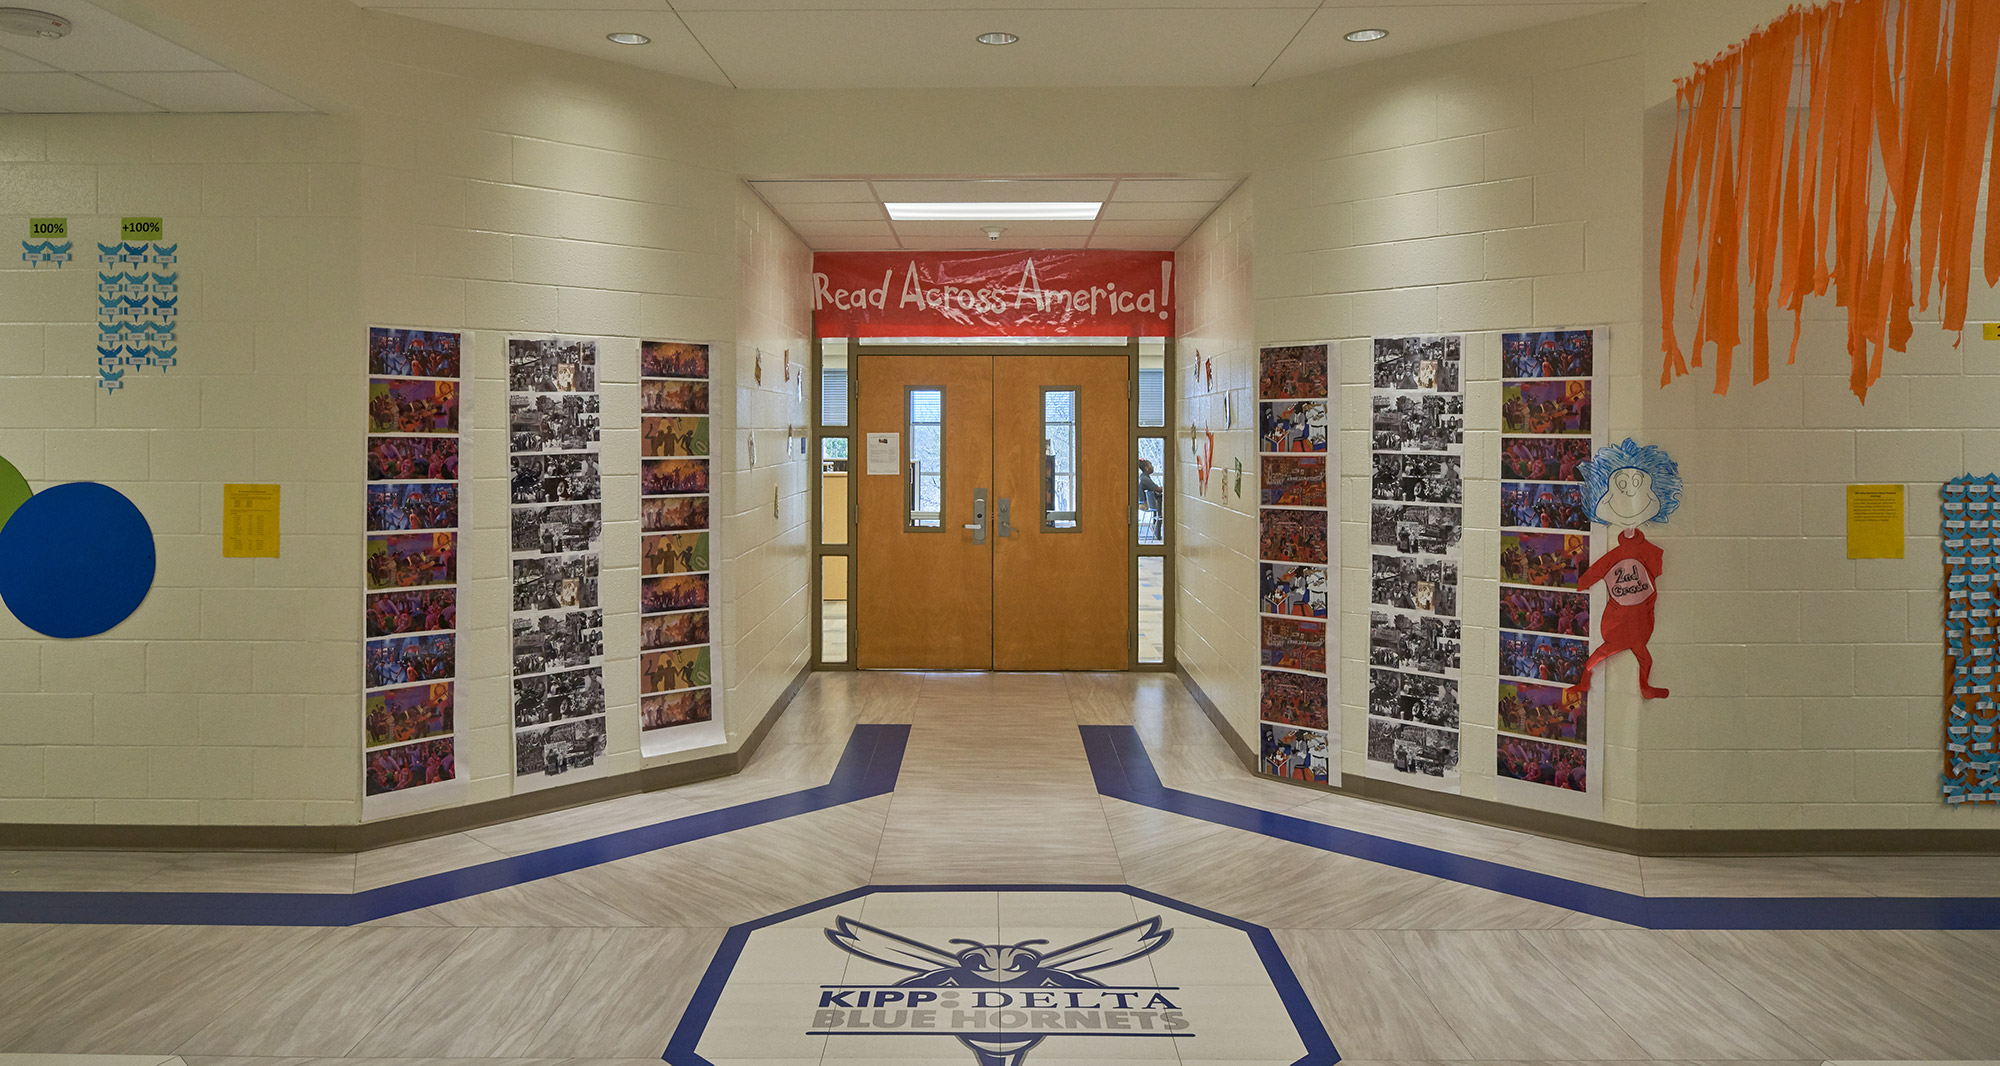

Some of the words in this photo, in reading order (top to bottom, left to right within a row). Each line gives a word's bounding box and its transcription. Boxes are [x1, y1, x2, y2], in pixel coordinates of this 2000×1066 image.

[33, 223, 64, 234] 100%
[122, 222, 160, 233] +100%
[812, 267, 892, 311] Read
[900, 260, 1006, 315] Across
[1014, 257, 1173, 320] America!
[1614, 564, 1640, 584] 2nd
[1611, 580, 1649, 598] Grade
[971, 991, 1182, 1010] DELTA
[811, 1009, 936, 1029] BLUE
[950, 1009, 1191, 1031] HORNETS
